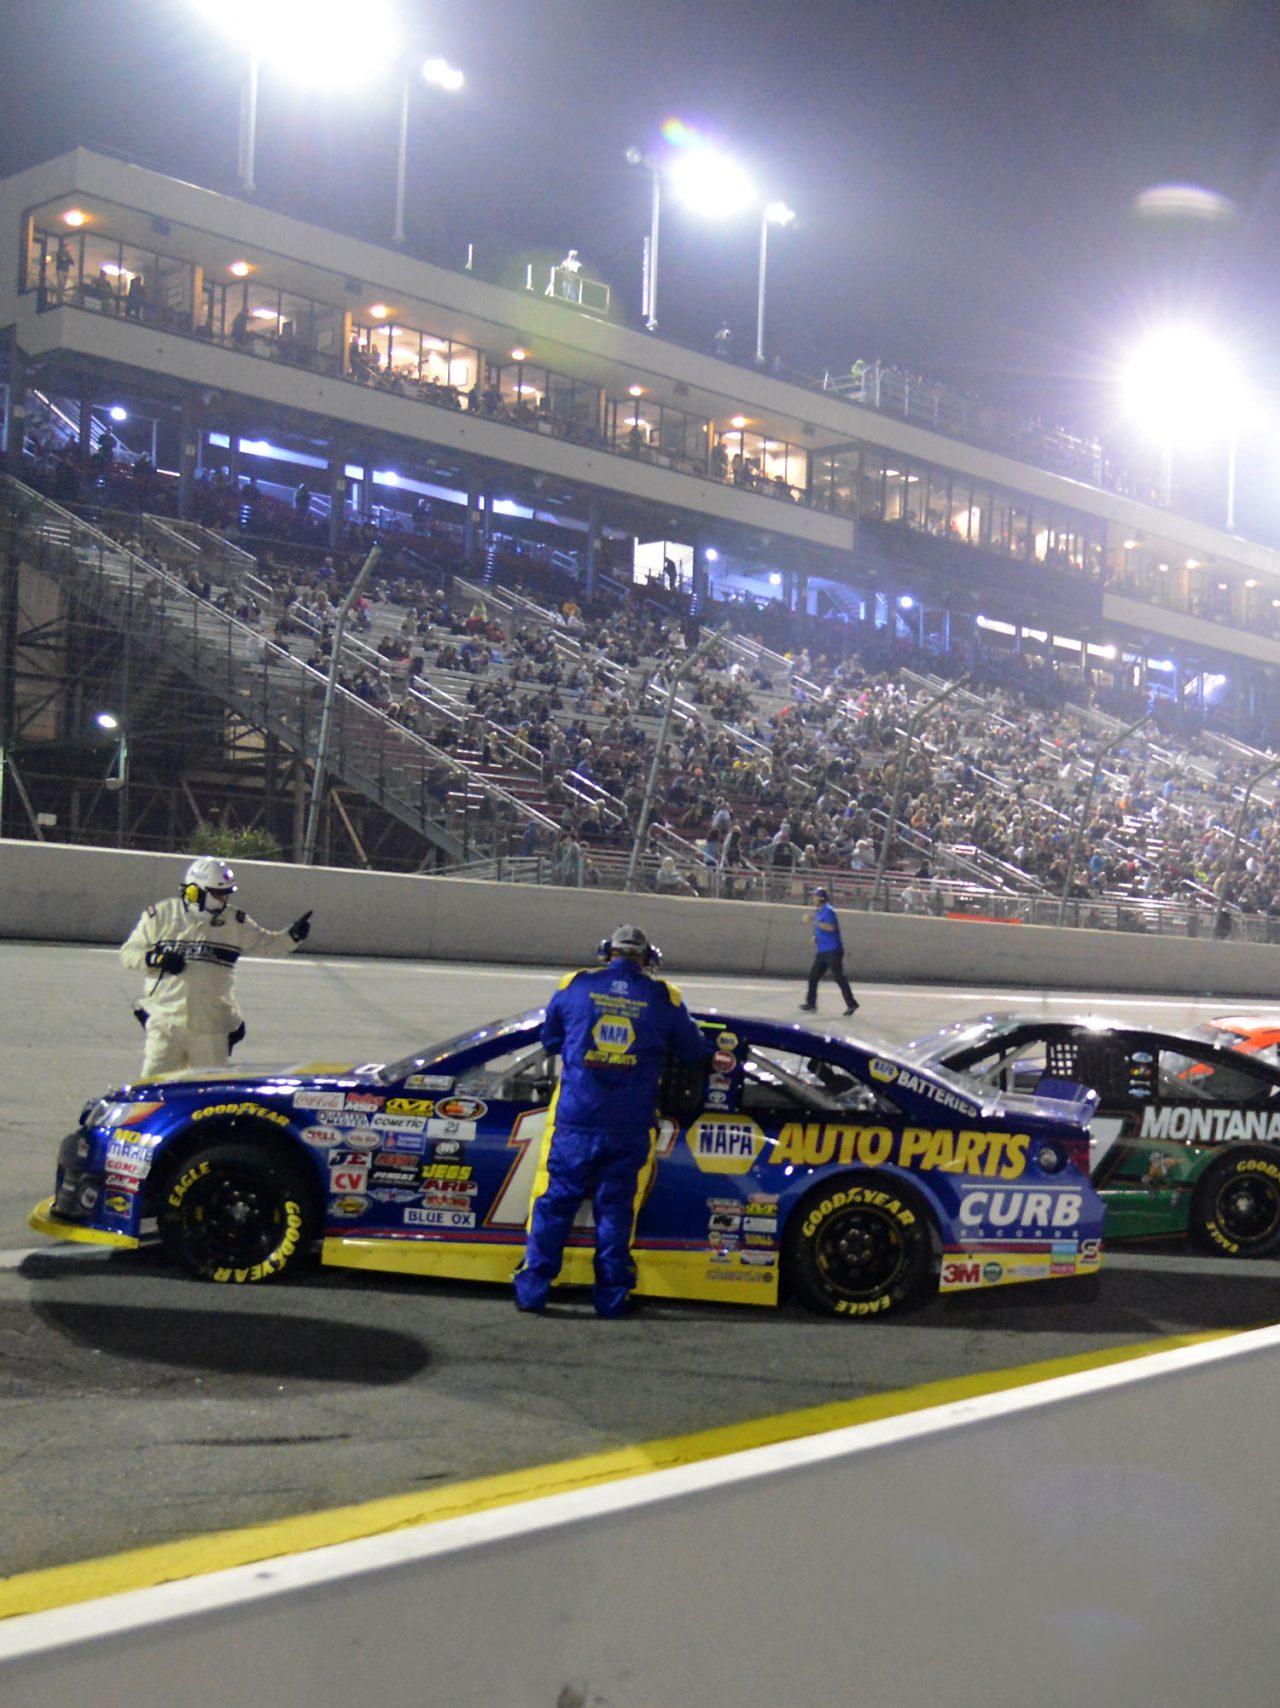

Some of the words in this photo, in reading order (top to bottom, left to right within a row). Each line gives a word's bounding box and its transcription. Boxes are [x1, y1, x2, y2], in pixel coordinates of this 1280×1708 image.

[599, 1023, 630, 1045] NAPA
[897, 1067, 978, 1118] BATTERIES
[191, 1101, 290, 1127] GOODYEAR
[700, 1122, 754, 1156] NAPA
[768, 1122, 894, 1168] AUTO
[898, 1126, 1031, 1180] PARTS
[329, 1151, 369, 1166] JE
[168, 1160, 212, 1207] EAGLE
[334, 1173, 363, 1190] CV
[422, 1163, 473, 1181] JEGS
[407, 1210, 444, 1224] BLUE
[451, 1213, 471, 1225] OX
[802, 1187, 916, 1238] GOODYEAR
[959, 1190, 1083, 1227] CURB
[212, 1200, 302, 1284] GOODYEAR
[942, 1262, 981, 1284] 3M
[834, 1294, 892, 1315] EAGLE
